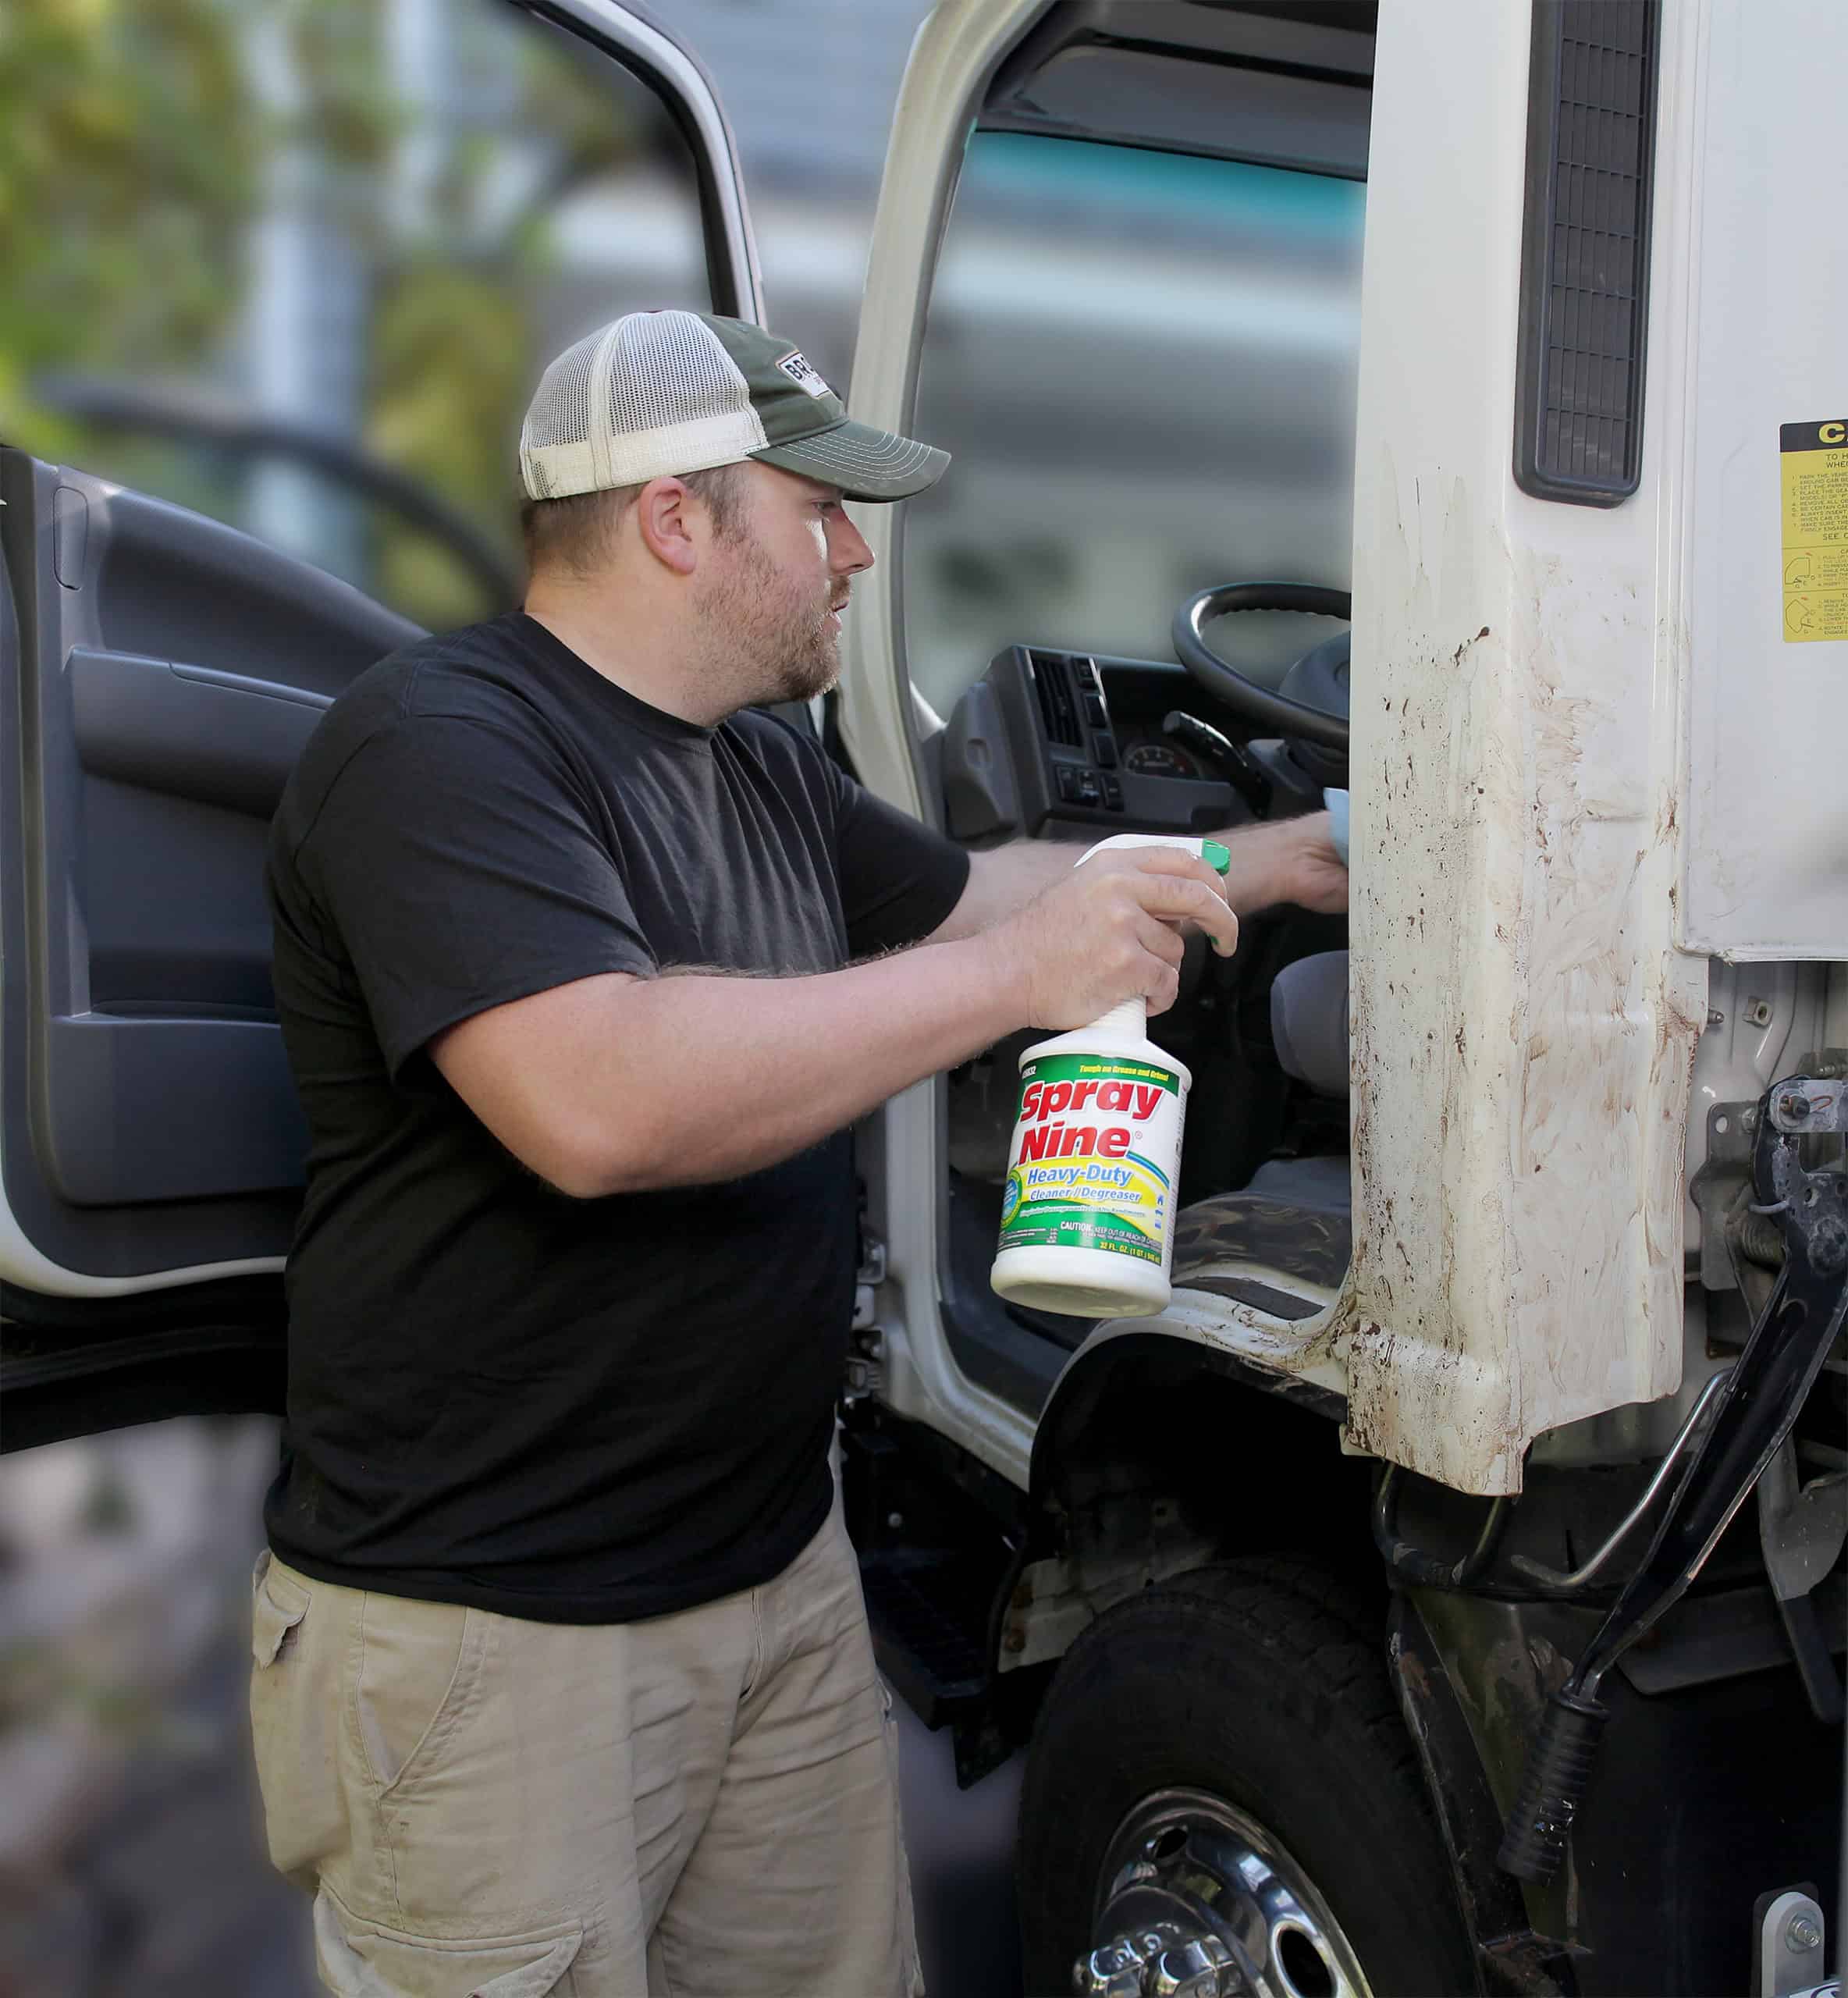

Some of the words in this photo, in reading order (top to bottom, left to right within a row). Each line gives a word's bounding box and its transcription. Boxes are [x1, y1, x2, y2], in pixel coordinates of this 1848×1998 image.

[1819, 423, 1848, 443] C
[1020, 1081, 1164, 1122] Spray
[1018, 1121, 1131, 1165] Nine
[1027, 1164, 1132, 1186] Heavy-Duty
